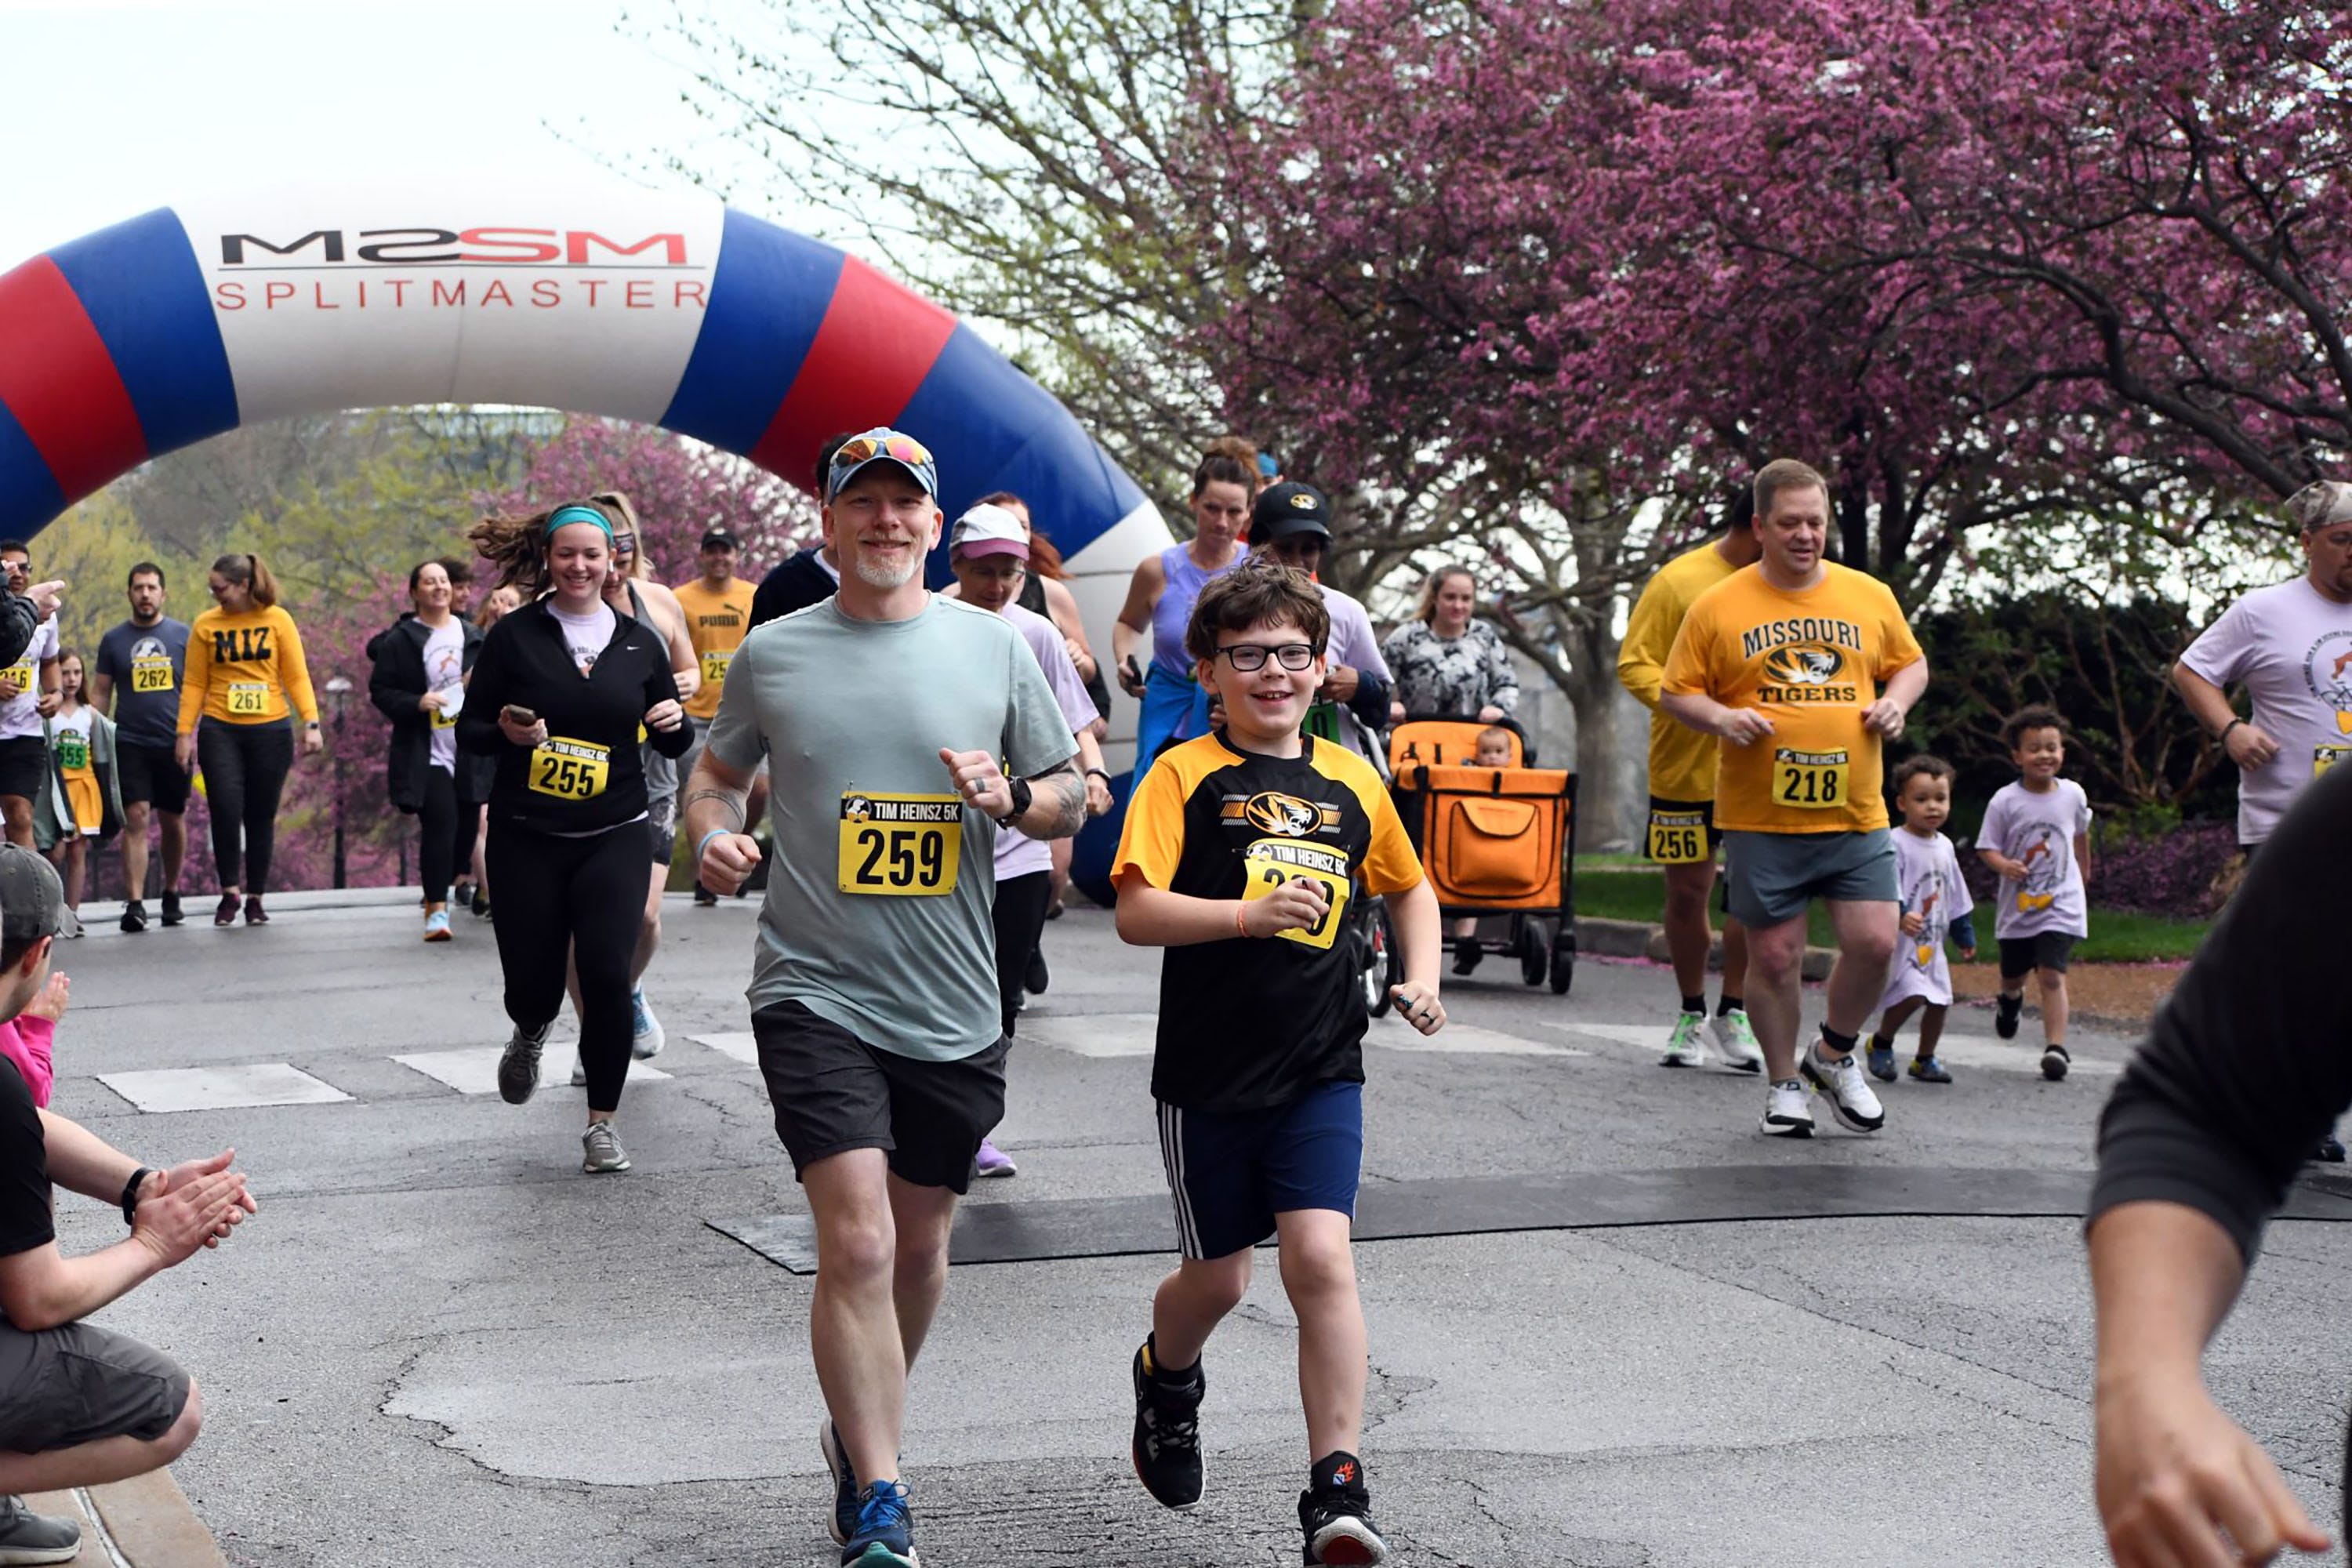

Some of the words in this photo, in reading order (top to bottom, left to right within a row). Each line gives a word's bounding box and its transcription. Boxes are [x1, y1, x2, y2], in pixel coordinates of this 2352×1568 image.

[216, 279, 706, 310] SPLITMASTER
[699, 615, 739, 627] PUMA
[213, 626, 271, 662] MIZ
[1743, 618, 1861, 659] MISSOURI
[139, 669, 167, 688] 262
[709, 662, 729, 680] 25
[234, 692, 263, 710] 261
[1757, 686, 1857, 702] TIGERS
[539, 757, 596, 797] 255
[1784, 768, 1837, 802] 218
[874, 802, 898, 819] TIM
[900, 803, 942, 821] HEINSZ
[943, 804, 958, 821] 5K
[856, 829, 943, 887] 259
[1655, 829, 1697, 858] 256
[1273, 844, 1296, 863] TIM
[1297, 848, 1334, 873] HEINSZ
[1335, 858, 1347, 877] 5K
